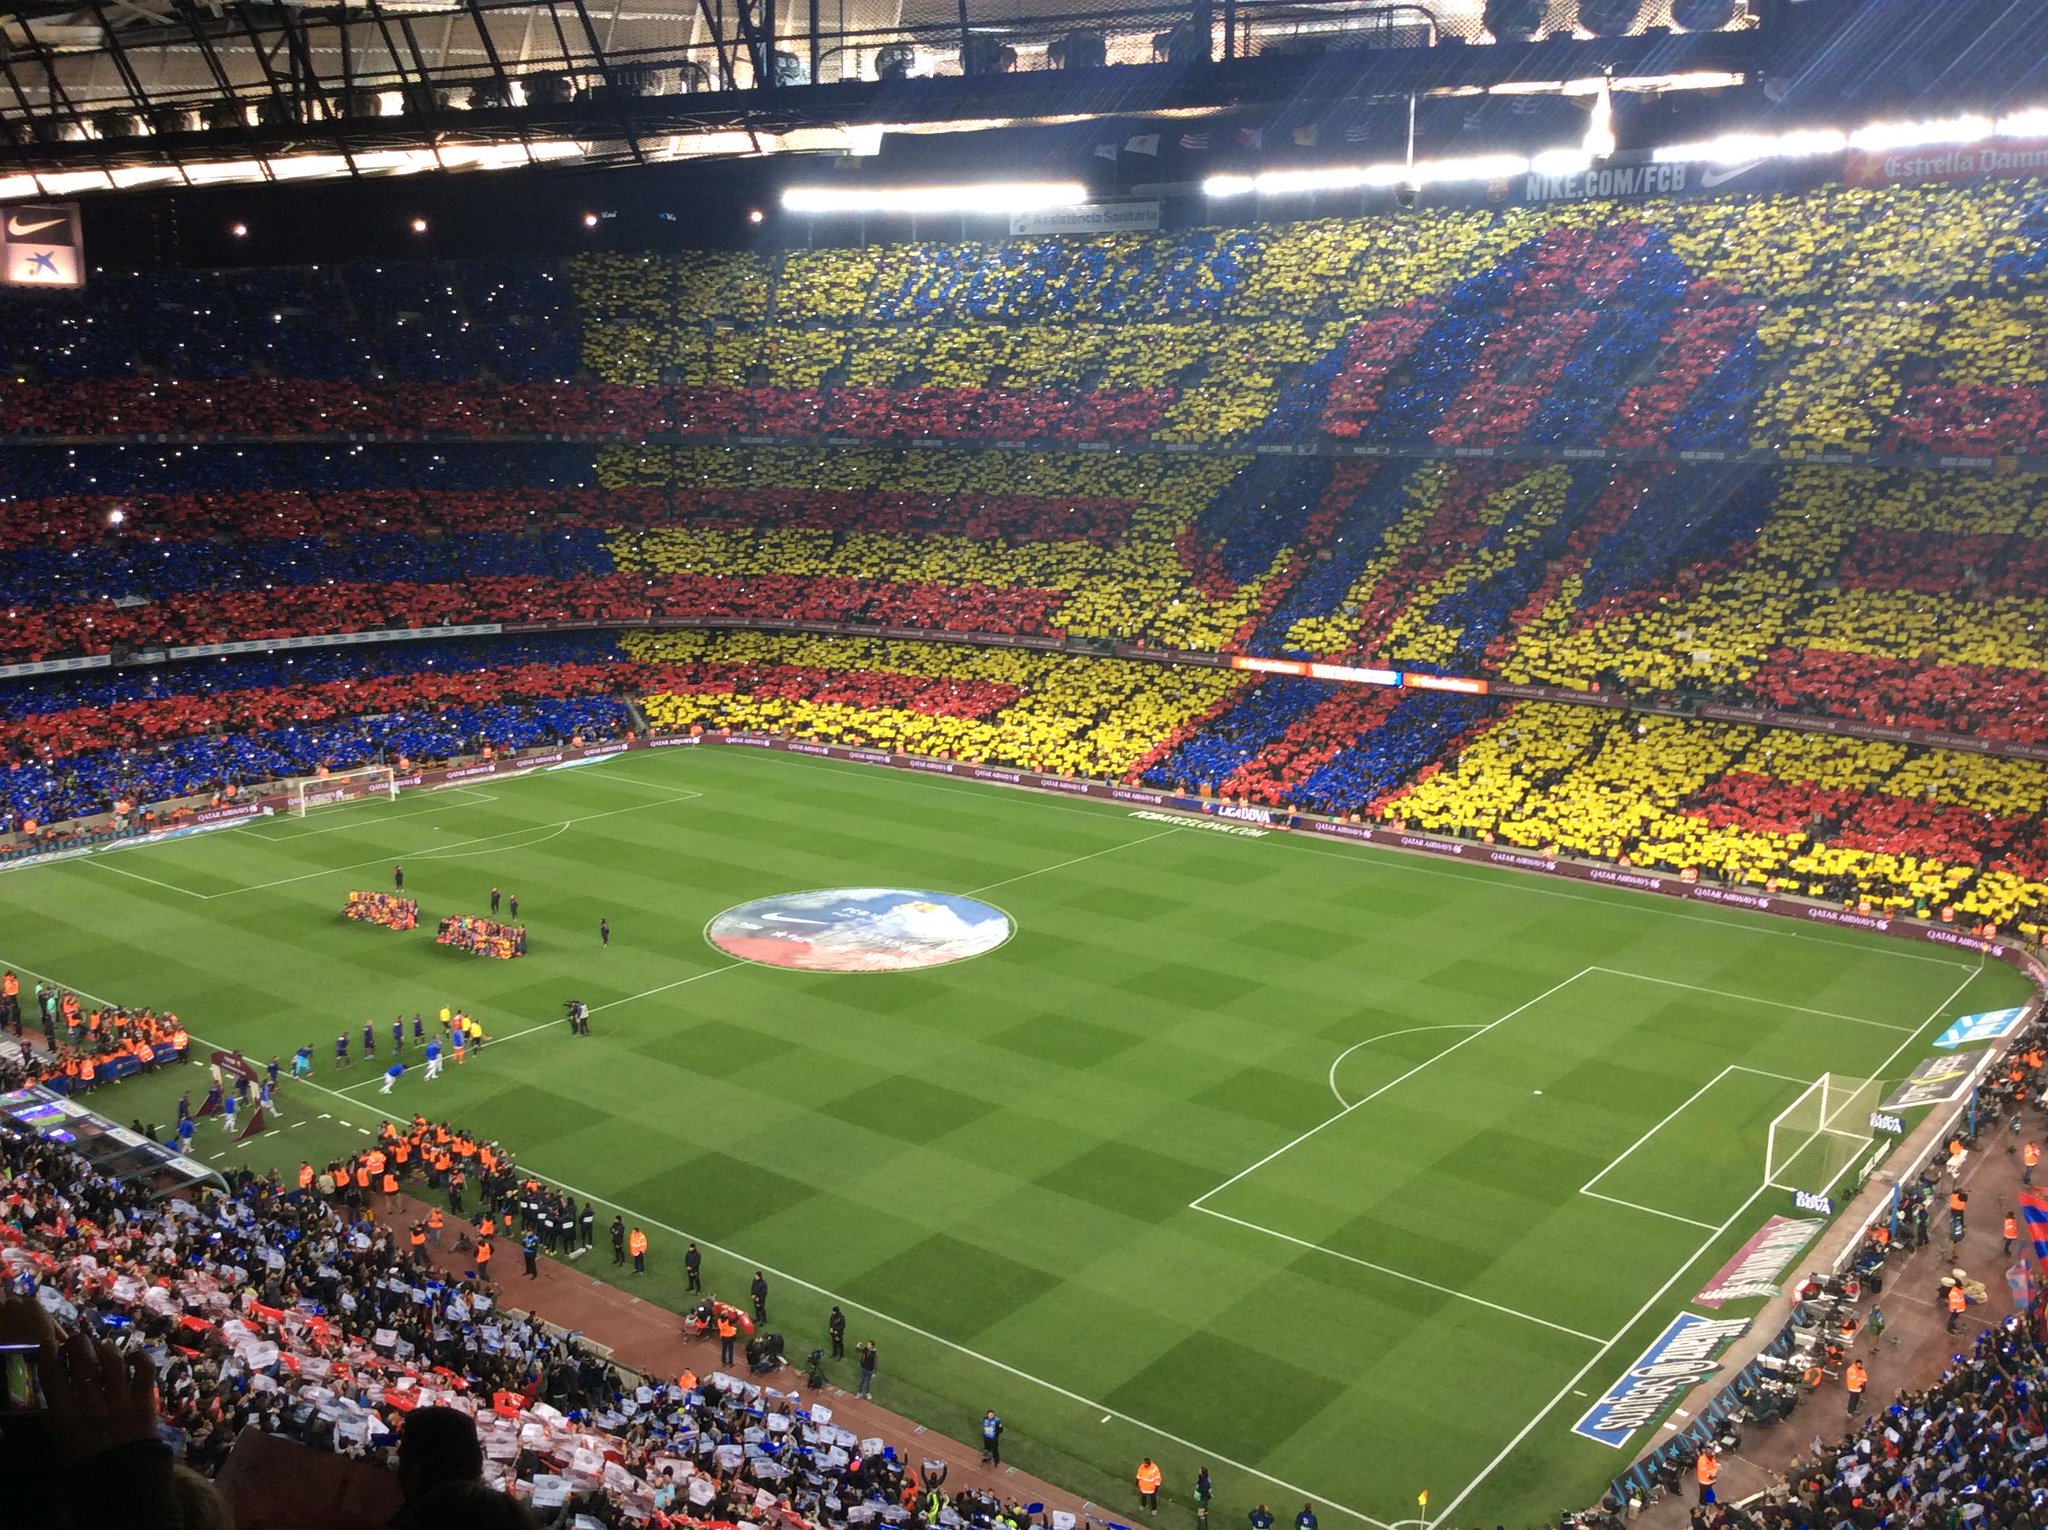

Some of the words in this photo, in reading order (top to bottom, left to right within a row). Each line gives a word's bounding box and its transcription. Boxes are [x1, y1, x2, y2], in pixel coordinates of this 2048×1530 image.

[1884, 151, 1975, 178] Estrella
[1526, 165, 1687, 201] NIKE.COM/FCB
[197, 810, 221, 822] QATAR
[1401, 836, 1424, 847] QATAR
[1490, 852, 1515, 863] QATAR
[1590, 868, 1617, 881] QATAR
[1617, 873, 1650, 887] AIRWAYS
[1694, 887, 1722, 900] QATAR
[1723, 892, 1757, 906] AIRWAYS
[1808, 907, 1838, 921] QATAR
[1839, 913, 1877, 928] AIRWAYS
[1927, 929, 1957, 944] QATAR
[1796, 1197, 1831, 1215] BBVA
